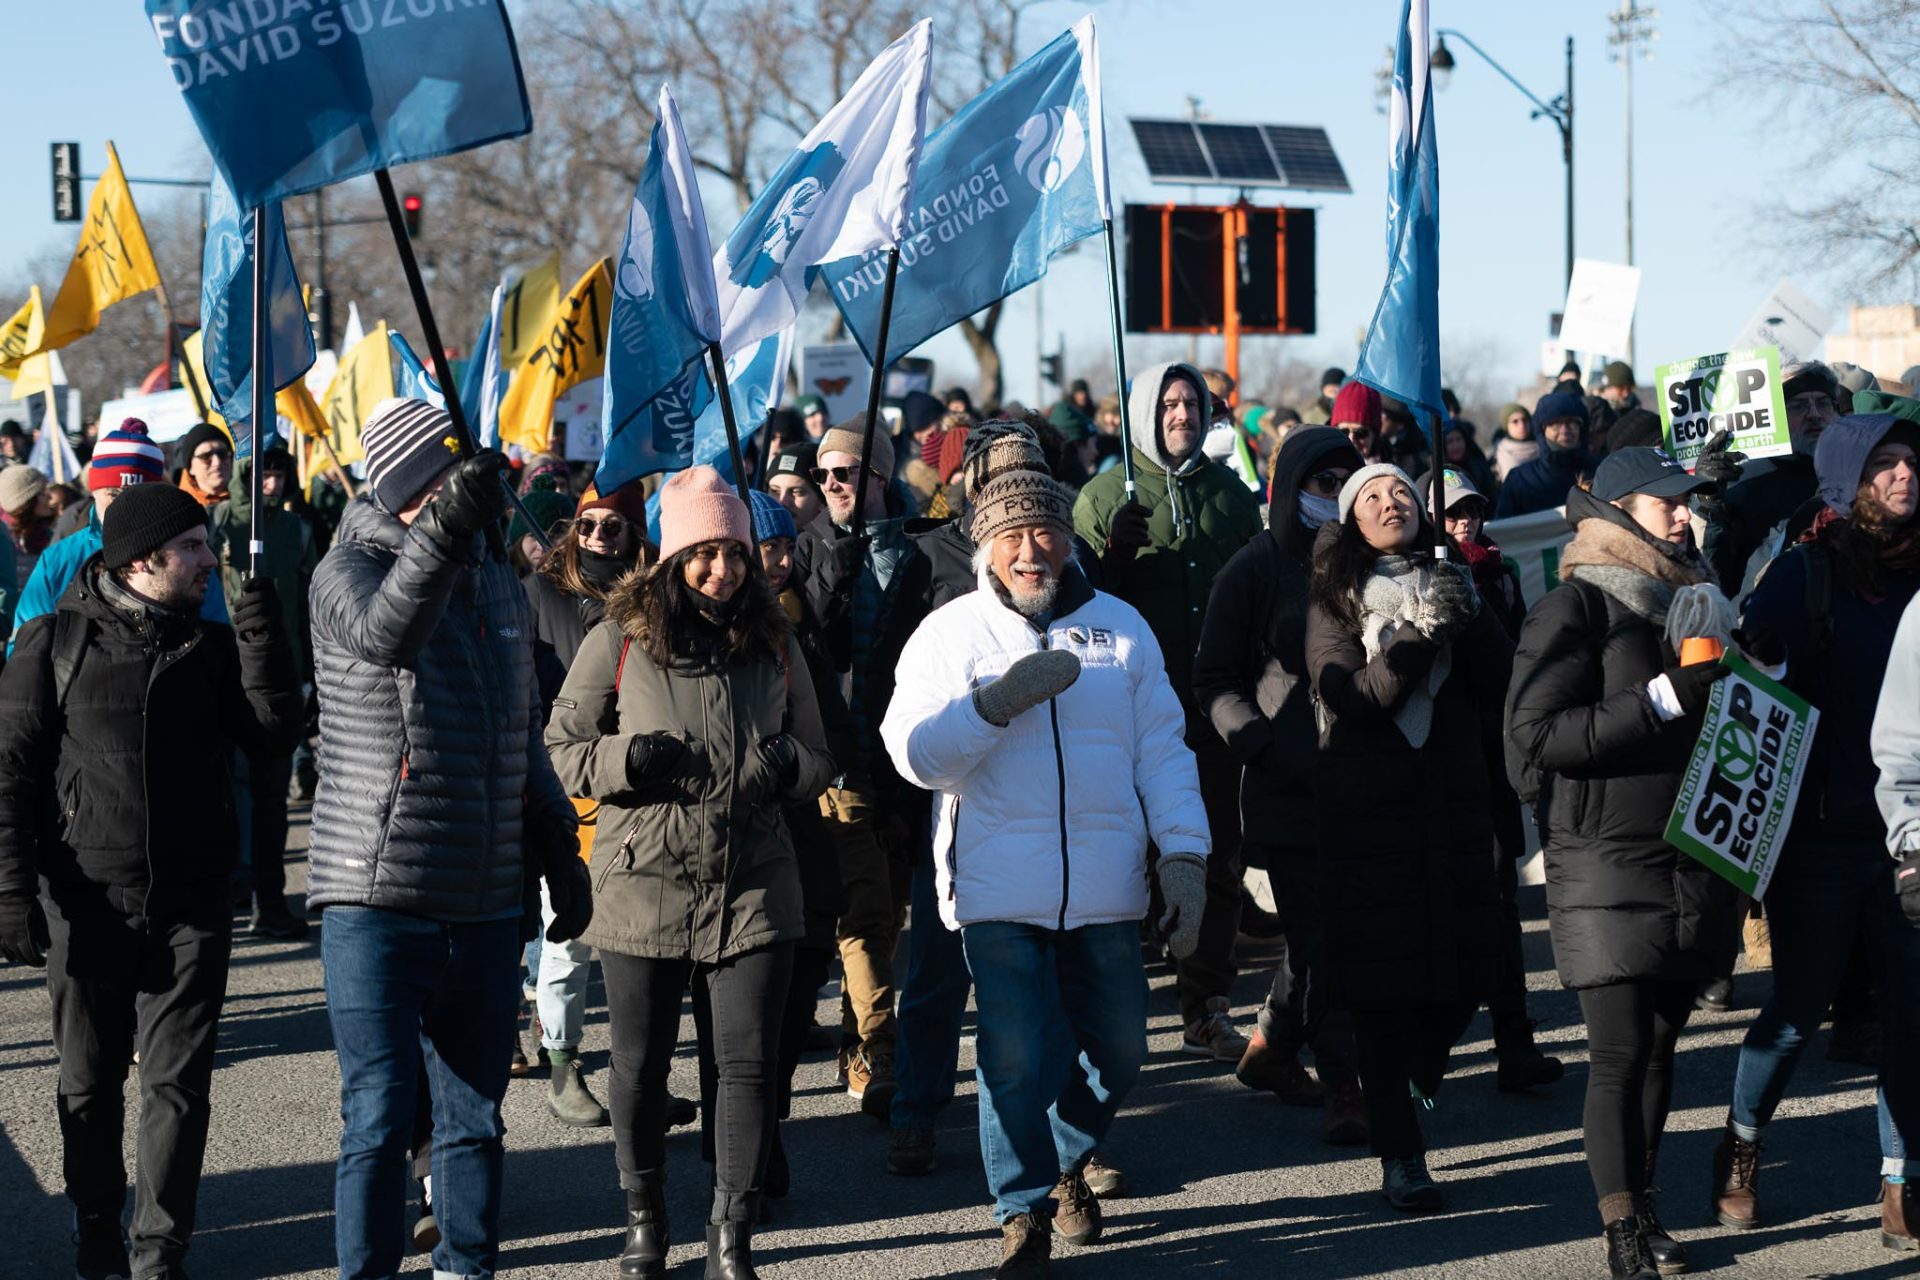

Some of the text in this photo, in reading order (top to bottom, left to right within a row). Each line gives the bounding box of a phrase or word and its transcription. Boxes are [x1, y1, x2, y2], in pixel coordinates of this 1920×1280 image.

[152, 0, 329, 48] FONDA
[166, 0, 487, 92] DAVID SUZU
[1668, 369, 1766, 418] STOP
[1709, 352, 1728, 367] the
[1673, 409, 1771, 443] ECOCIDE
[1676, 433, 1774, 461] prote earth
[1677, 679, 1724, 815] change the law
[1695, 682, 1760, 845] STOP
[1729, 704, 1791, 863] ECOCIDE
[1752, 805, 1782, 875] protect
[1774, 772, 1790, 802] the
[1784, 720, 1805, 768] earth
